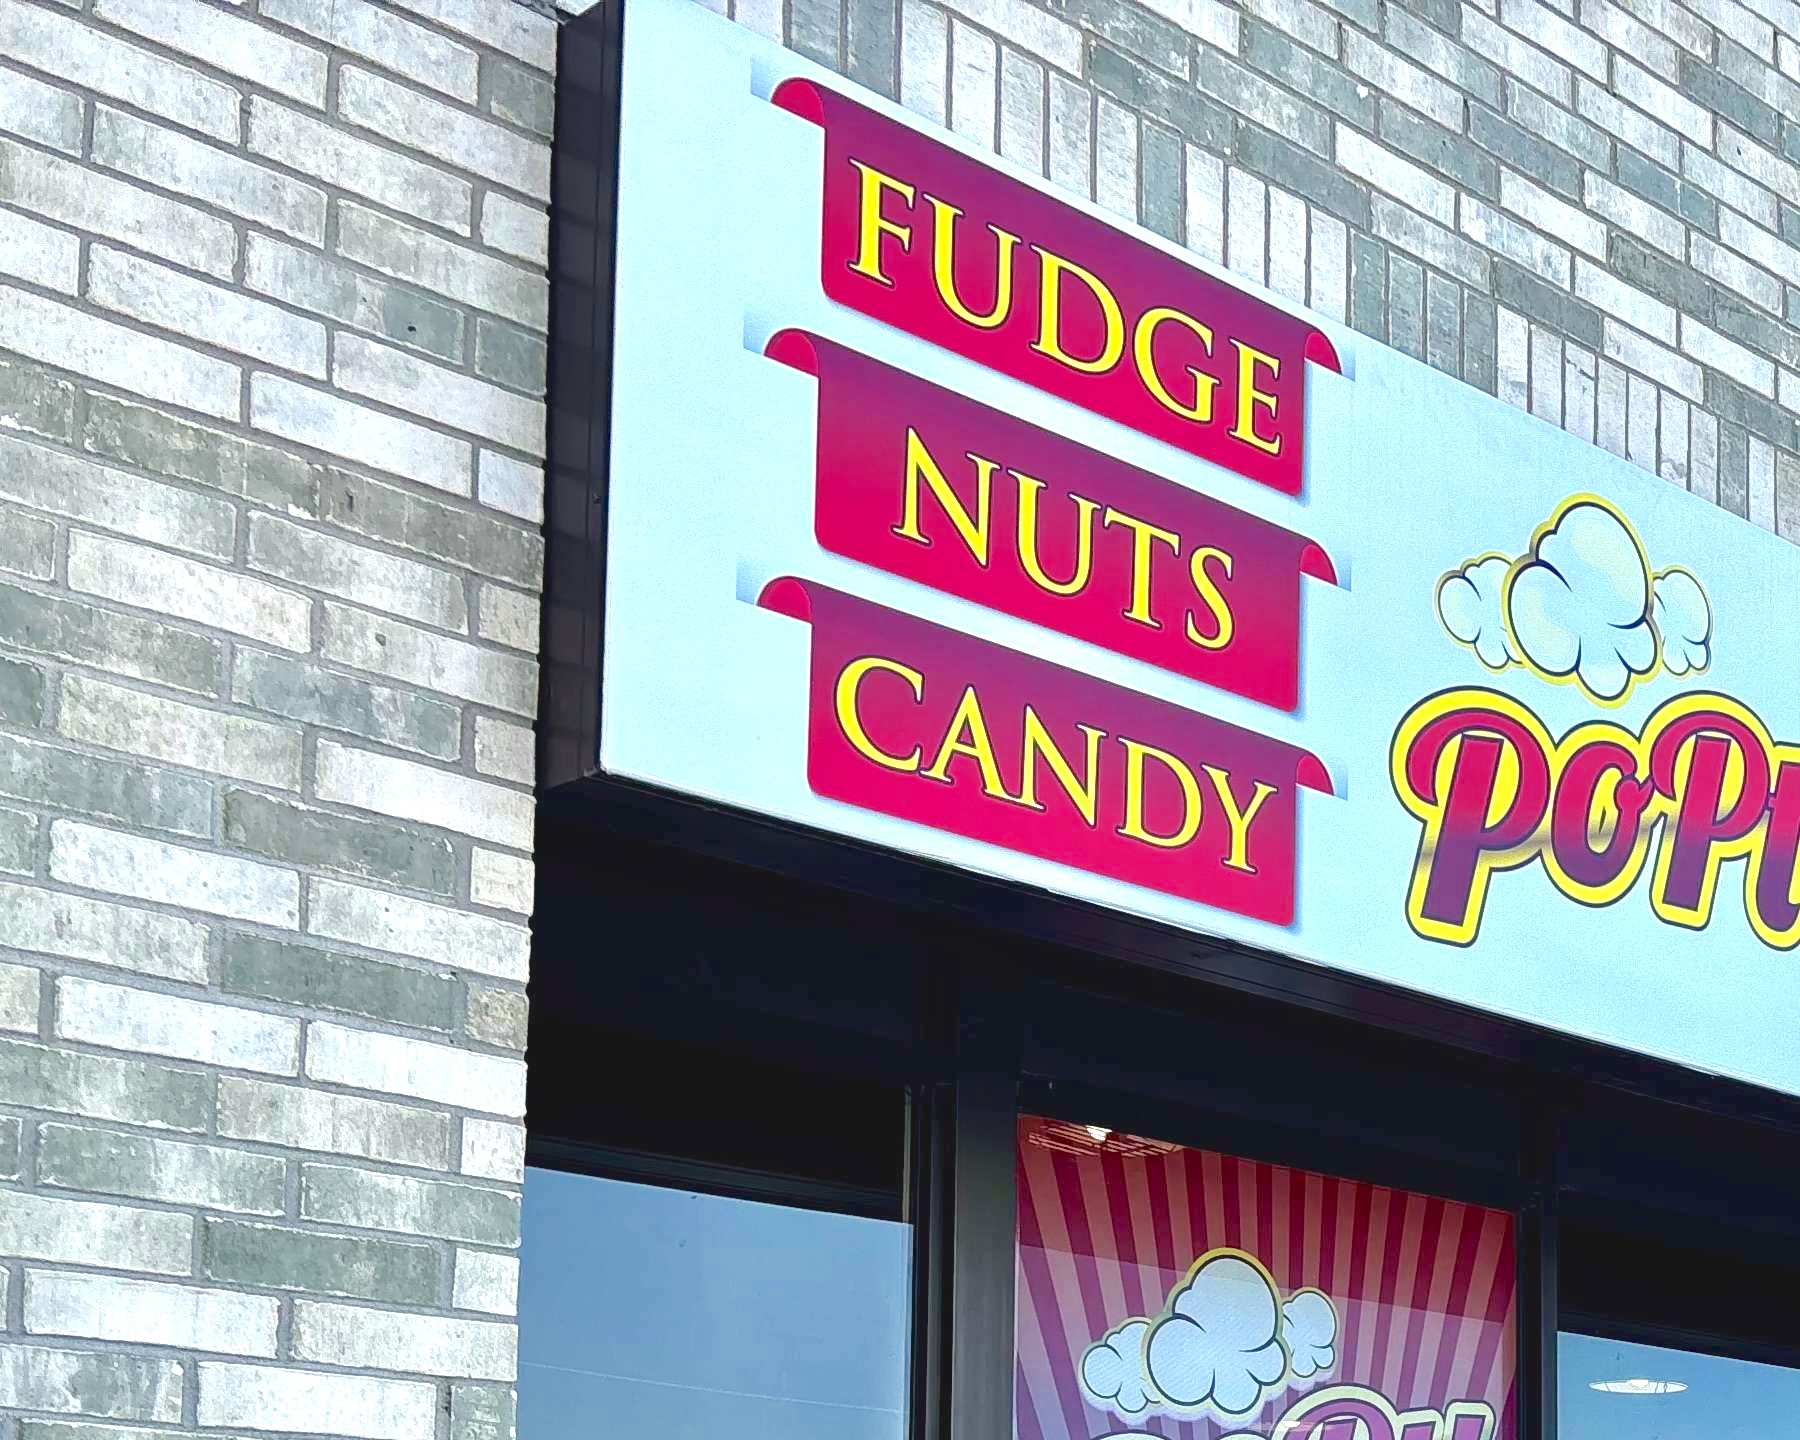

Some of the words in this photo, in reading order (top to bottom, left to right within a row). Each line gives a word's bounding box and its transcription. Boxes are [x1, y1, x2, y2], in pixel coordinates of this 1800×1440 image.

[846, 157, 1284, 456] FUDGE
[891, 426, 1237, 651] NUTS
[833, 656, 1278, 873] CANDY
